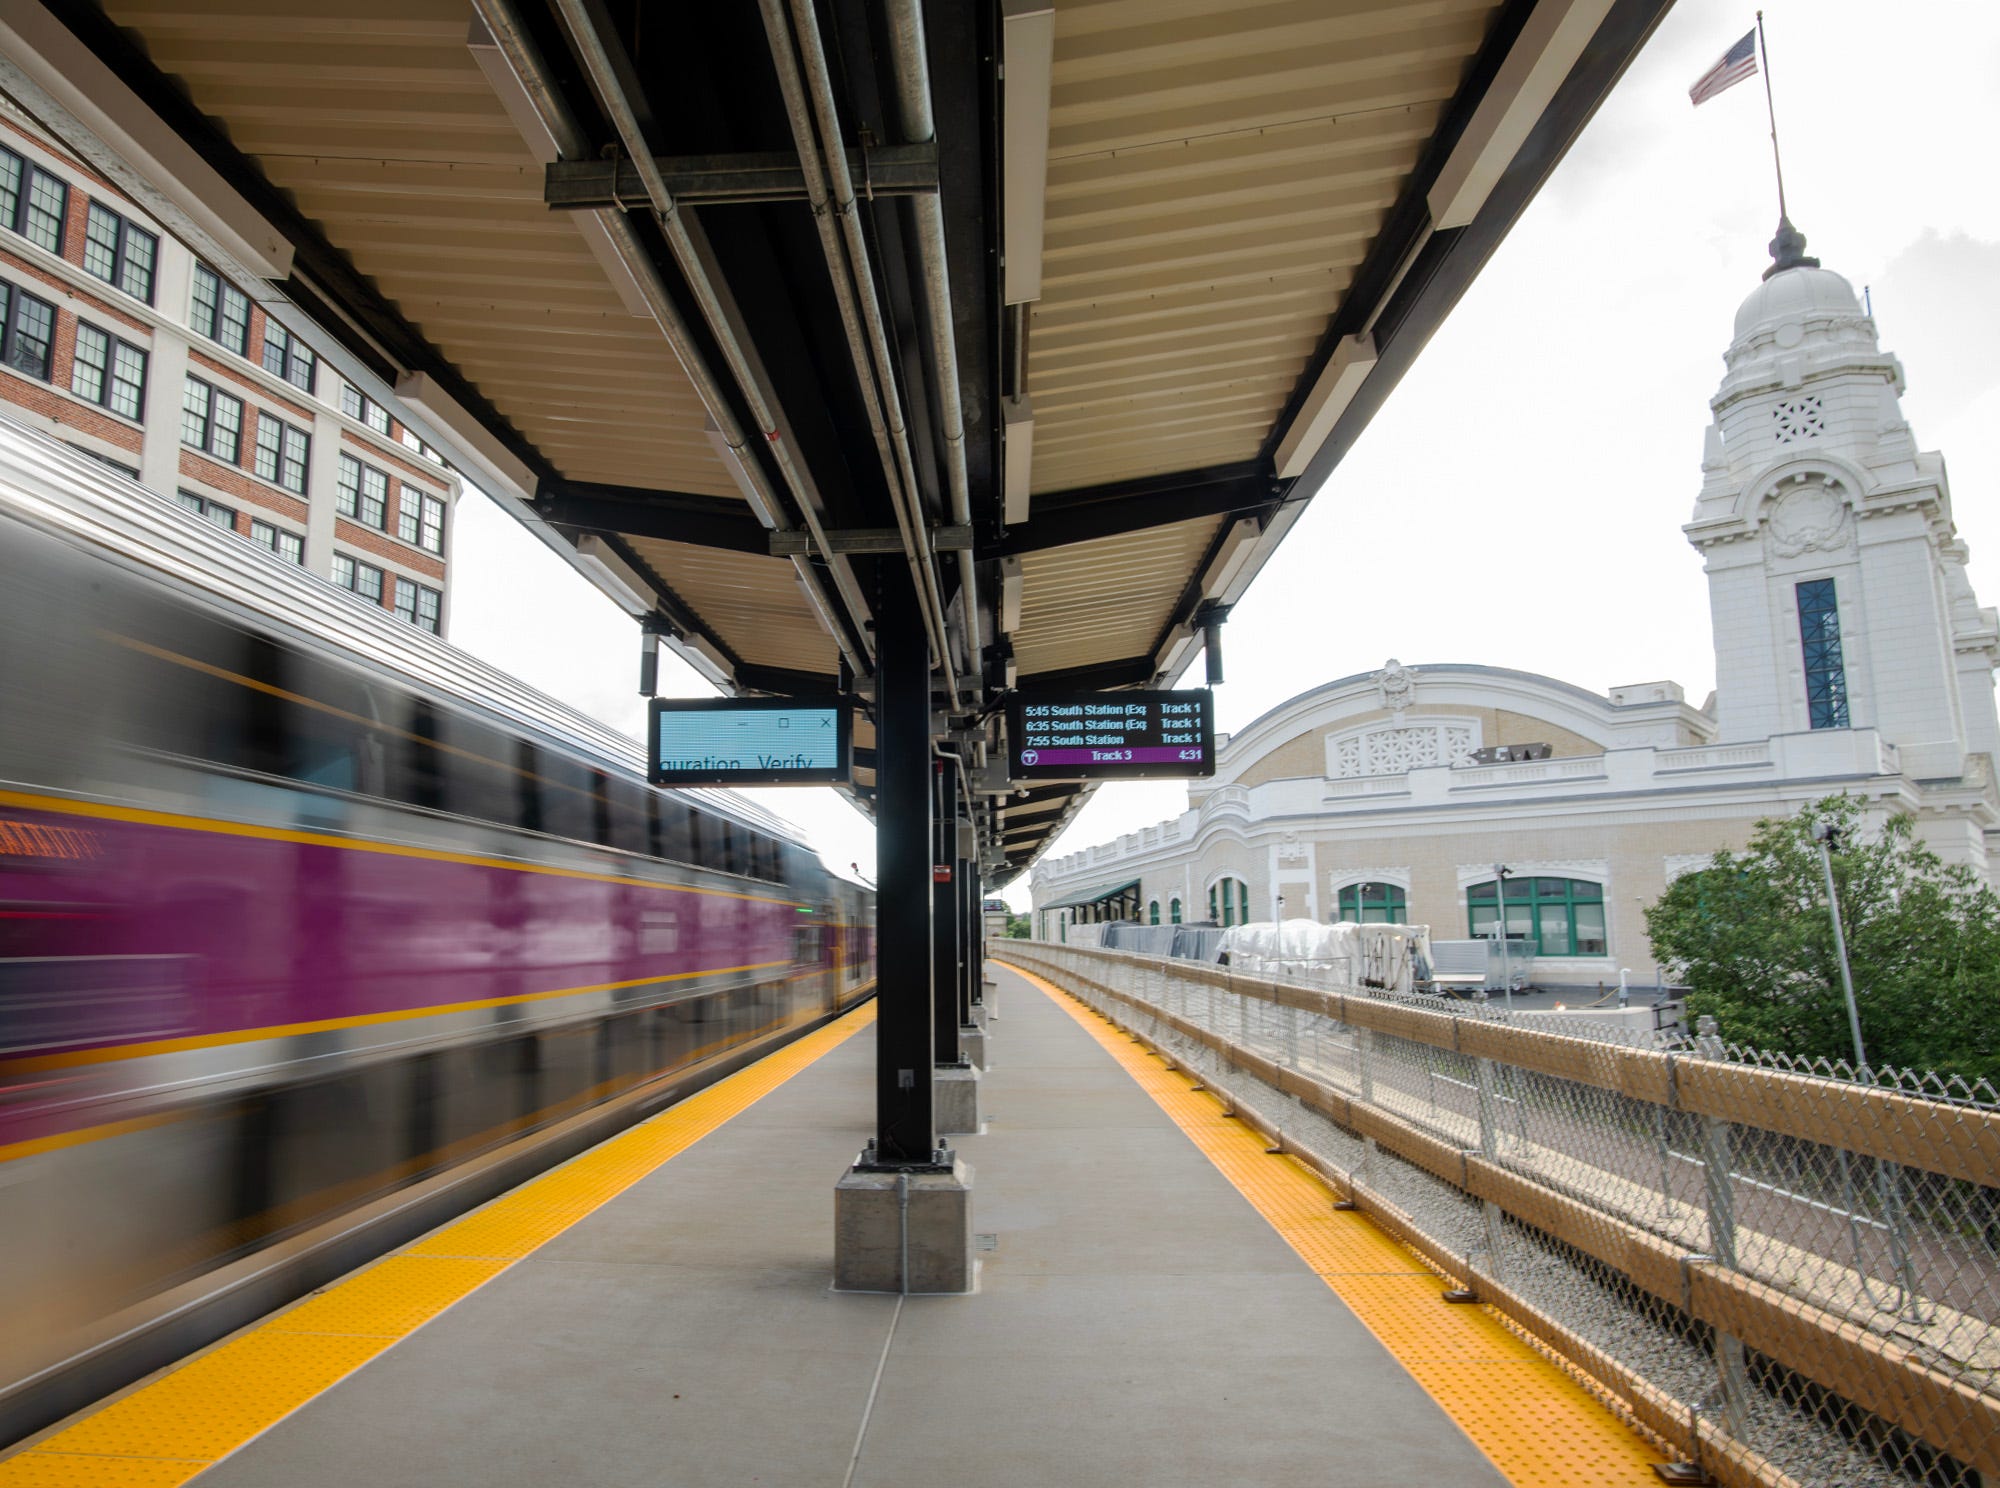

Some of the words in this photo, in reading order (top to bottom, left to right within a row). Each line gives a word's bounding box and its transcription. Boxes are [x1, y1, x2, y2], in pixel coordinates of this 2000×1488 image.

[1025, 706, 1049, 716] 5:45
[1050, 705, 1083, 716] South
[1084, 704, 1124, 715] Station
[1160, 703, 1192, 714] Track
[1194, 702, 1201, 713] 1
[1026, 721, 1050, 731] 6:35
[1051, 720, 1083, 731] South
[1085, 719, 1124, 730] Station
[1160, 718, 1193, 729] Track
[1194, 717, 1201, 728] 1
[1026, 736, 1050, 746] 7:55
[1051, 735, 1084, 746] South
[1085, 734, 1124, 745] Station
[1161, 733, 1193, 744] Track
[1194, 732, 1202, 743] 1
[757, 754, 813, 769] Verify
[1091, 750, 1122, 761] Track
[1124, 749, 1133, 761] 3
[1178, 749, 1202, 760] 4:31
